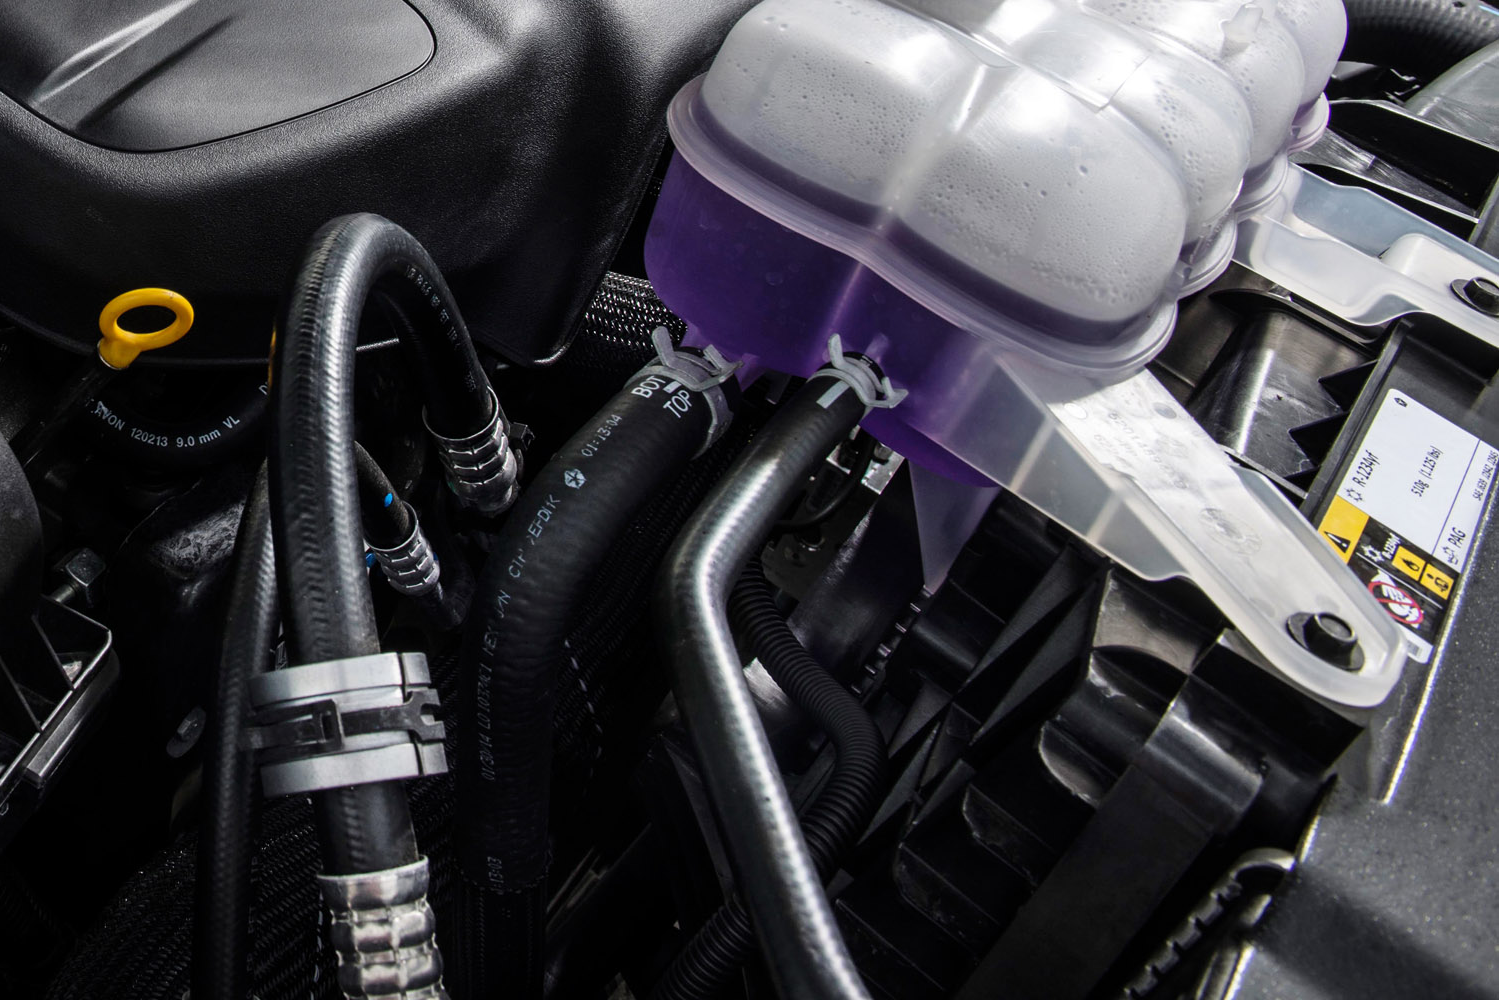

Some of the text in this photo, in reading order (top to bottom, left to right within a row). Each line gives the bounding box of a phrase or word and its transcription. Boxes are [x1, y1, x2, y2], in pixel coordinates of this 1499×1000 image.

[631, 376, 666, 398] BOT
[663, 390, 692, 418] TOP
[130, 428, 168, 447] 120213
[176, 435, 196, 448] 9.0
[199, 428, 221, 444] mm
[223, 415, 241, 430] VL
[1352, 450, 1380, 488] R-1234yf
[1411, 479, 1430, 497] 510g
[1447, 526, 1466, 549] PAG
